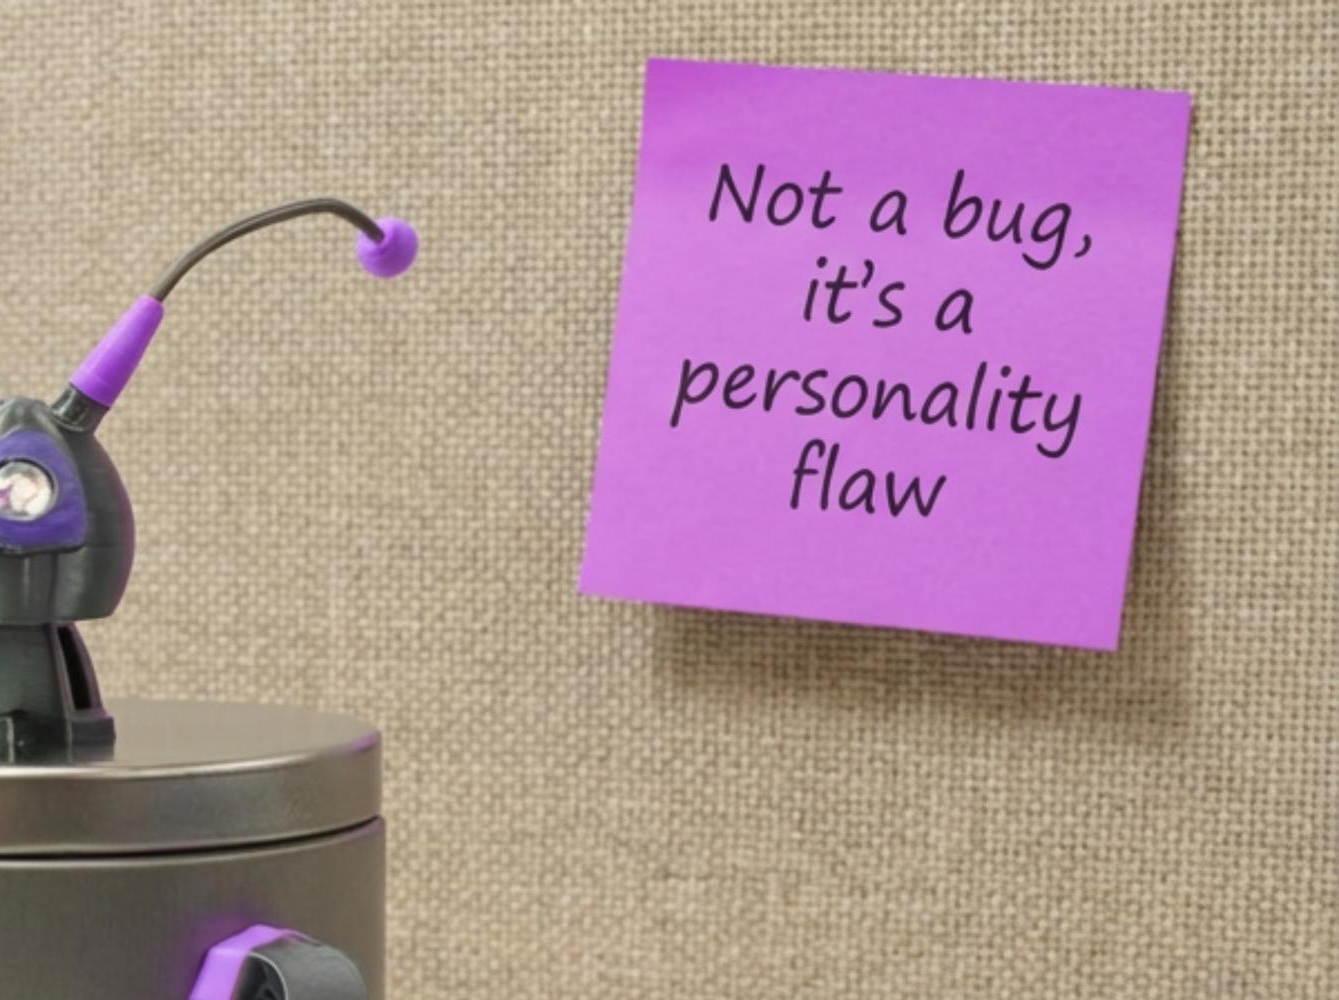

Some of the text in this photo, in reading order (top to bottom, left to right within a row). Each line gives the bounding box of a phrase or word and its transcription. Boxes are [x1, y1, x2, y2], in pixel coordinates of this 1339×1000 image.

[708, 163, 1093, 271] Not a bug,
[803, 256, 975, 335] it's a
[669, 358, 1083, 459] personality
[789, 438, 948, 517] flaw
